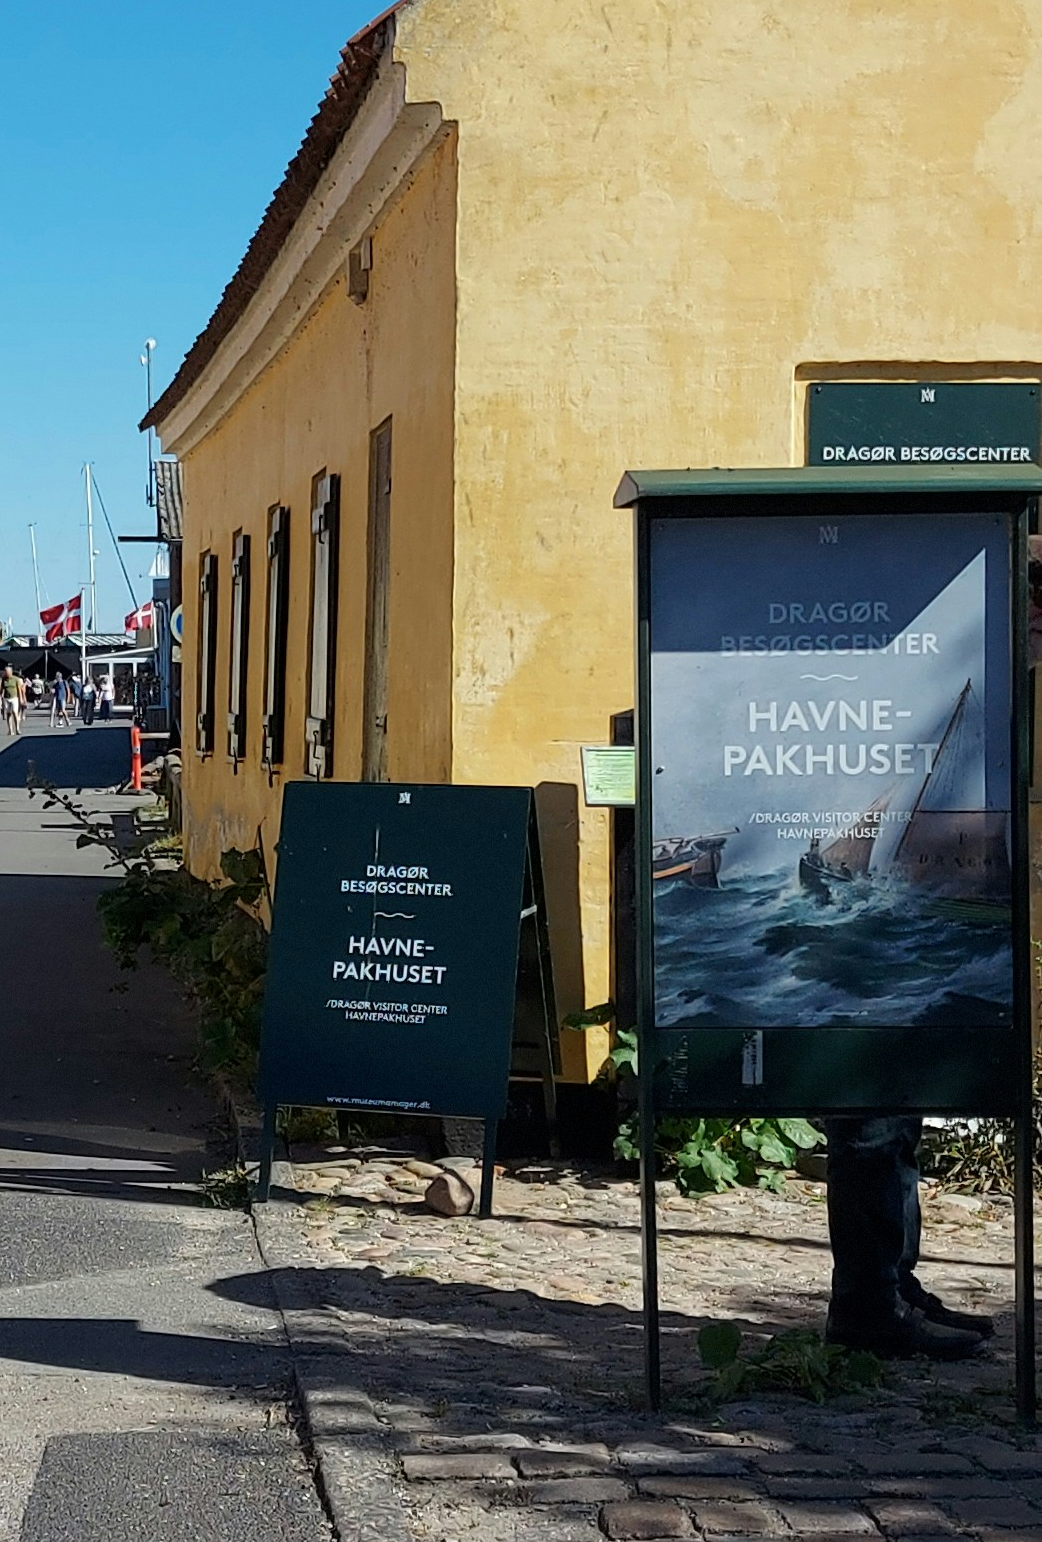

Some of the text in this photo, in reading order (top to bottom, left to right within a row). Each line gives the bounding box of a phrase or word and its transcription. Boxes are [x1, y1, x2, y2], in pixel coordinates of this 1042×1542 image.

[823, 445, 1032, 462] DRAGØR BESØGSCENTER
[769, 602, 891, 624] DRAGØR
[721, 633, 940, 656] BESØGSCENTER
[749, 700, 912, 732] HAVNE-
[724, 744, 939, 776] PAKHUSET
[812, 812, 860, 824] VISITOR
[863, 811, 912, 823] CENTER
[777, 827, 885, 840] HAVNEPAKHUSET
[366, 865, 430, 879] DRAGØR
[340, 880, 452, 897] BESØGSCENTER
[348, 935, 435, 958] HAVNE-
[332, 961, 447, 985] PAKHUSET
[372, 1001, 409, 1013] VISITOR
[410, 1003, 448, 1015] CENTER
[345, 1010, 426, 1024] HAVNEPAKHUSET
